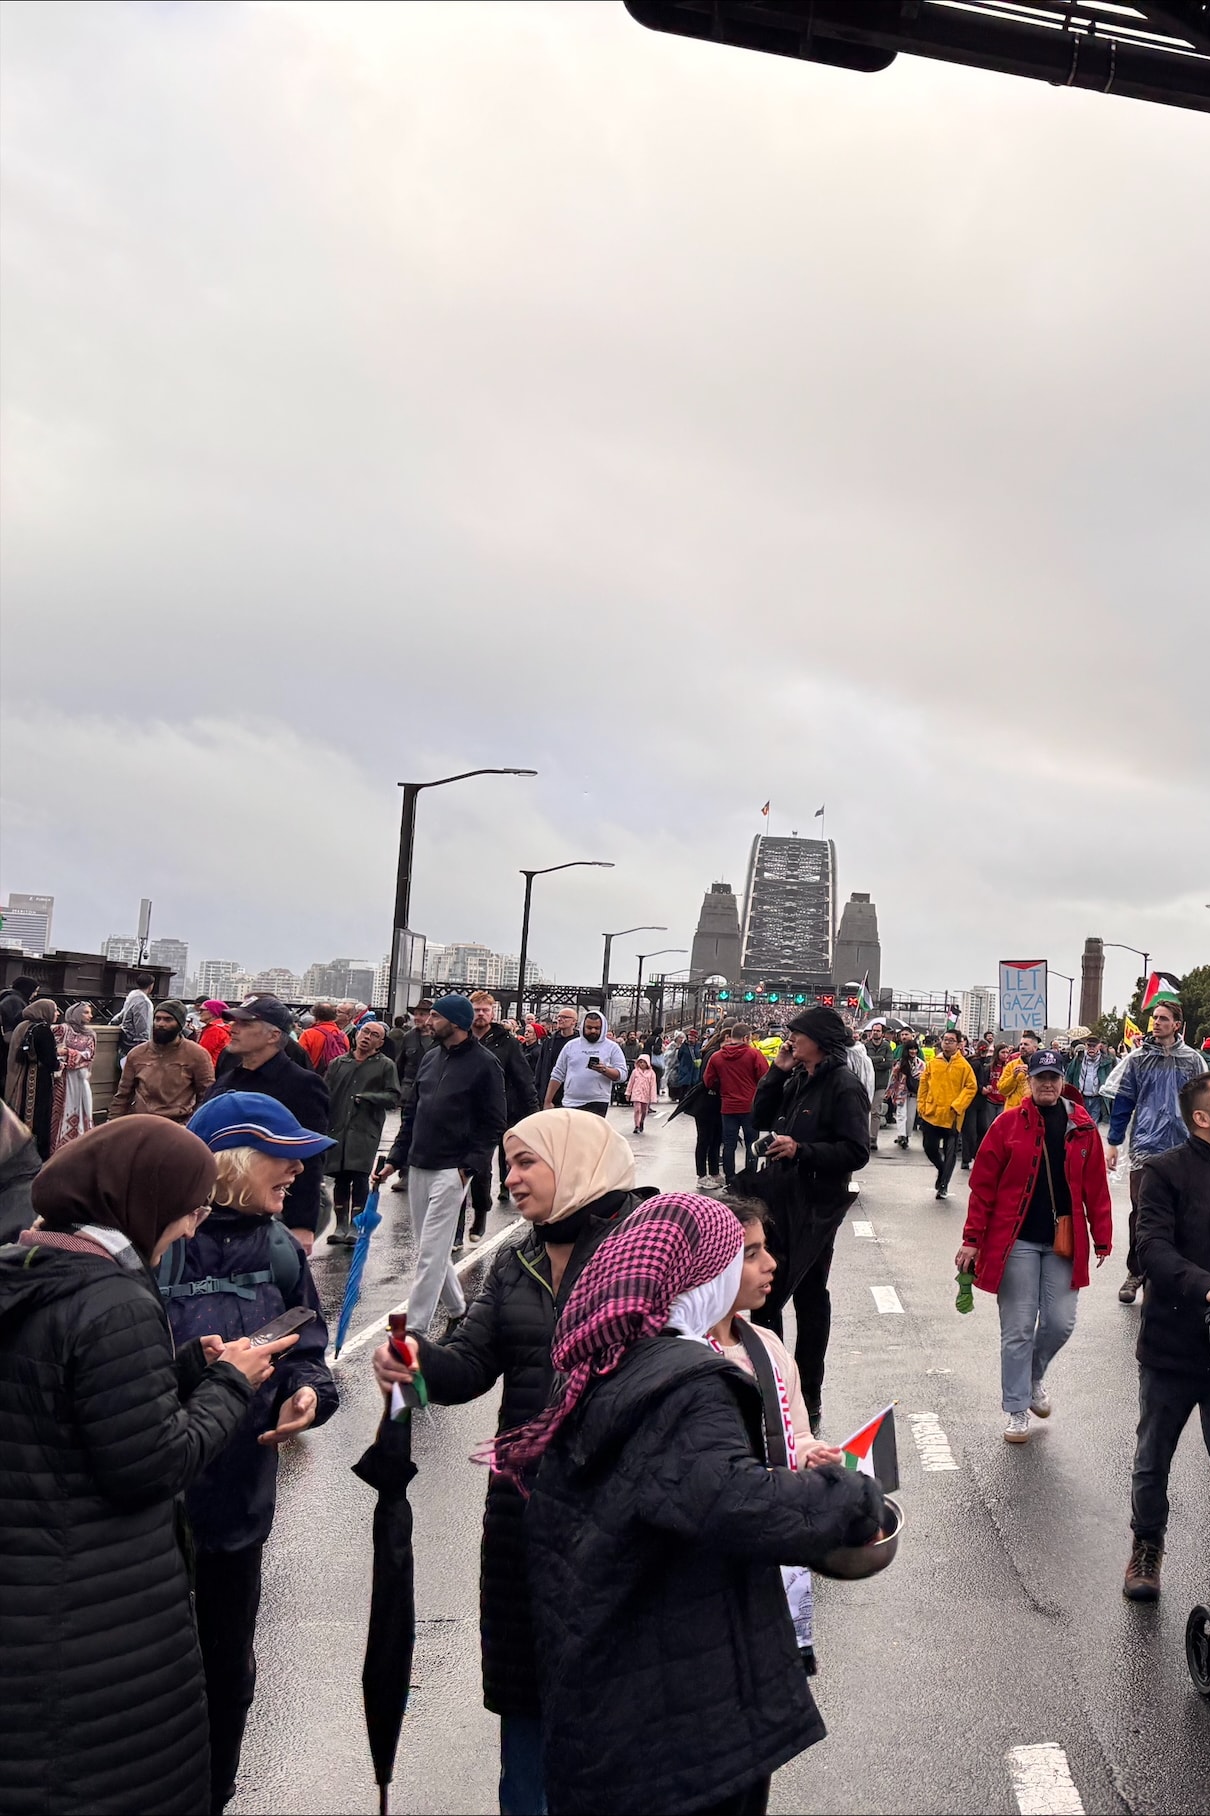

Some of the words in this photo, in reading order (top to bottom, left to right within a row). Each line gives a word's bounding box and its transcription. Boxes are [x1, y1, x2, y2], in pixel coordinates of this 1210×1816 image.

[1006, 969, 1041, 990] LET
[1002, 993, 1046, 1011] GAZA
[1003, 1012, 1042, 1028] LIVE
